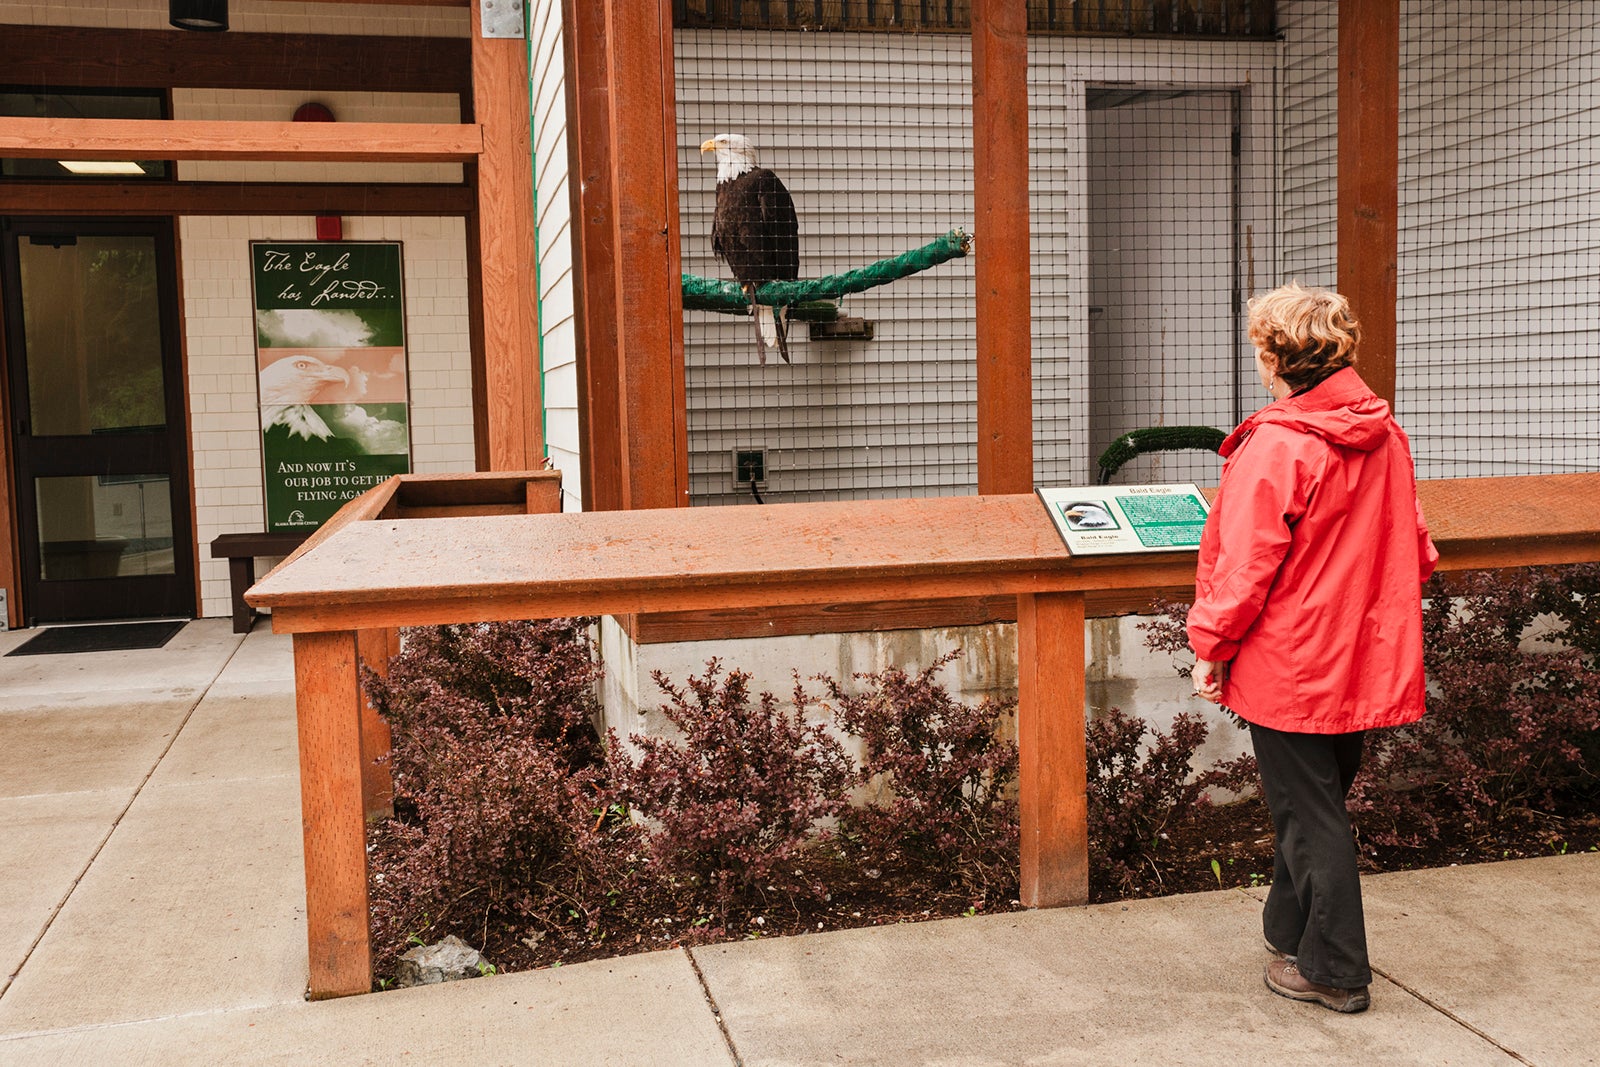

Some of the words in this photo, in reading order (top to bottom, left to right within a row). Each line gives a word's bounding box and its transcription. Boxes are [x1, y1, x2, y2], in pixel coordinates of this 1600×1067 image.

[263, 250, 293, 272] The
[299, 251, 351, 286] Eagle
[277, 283, 302, 301] has
[306, 462, 333, 472] NOW
[335, 459, 356, 472] IT'S
[284, 477, 309, 487] OUR
[310, 477, 332, 488] JOB
[333, 476, 349, 486] TO
[351, 475, 373, 485] GET
[297, 490, 337, 501] FLYING
[1129, 487, 1149, 495] Bald
[1150, 487, 1172, 495] Eagle
